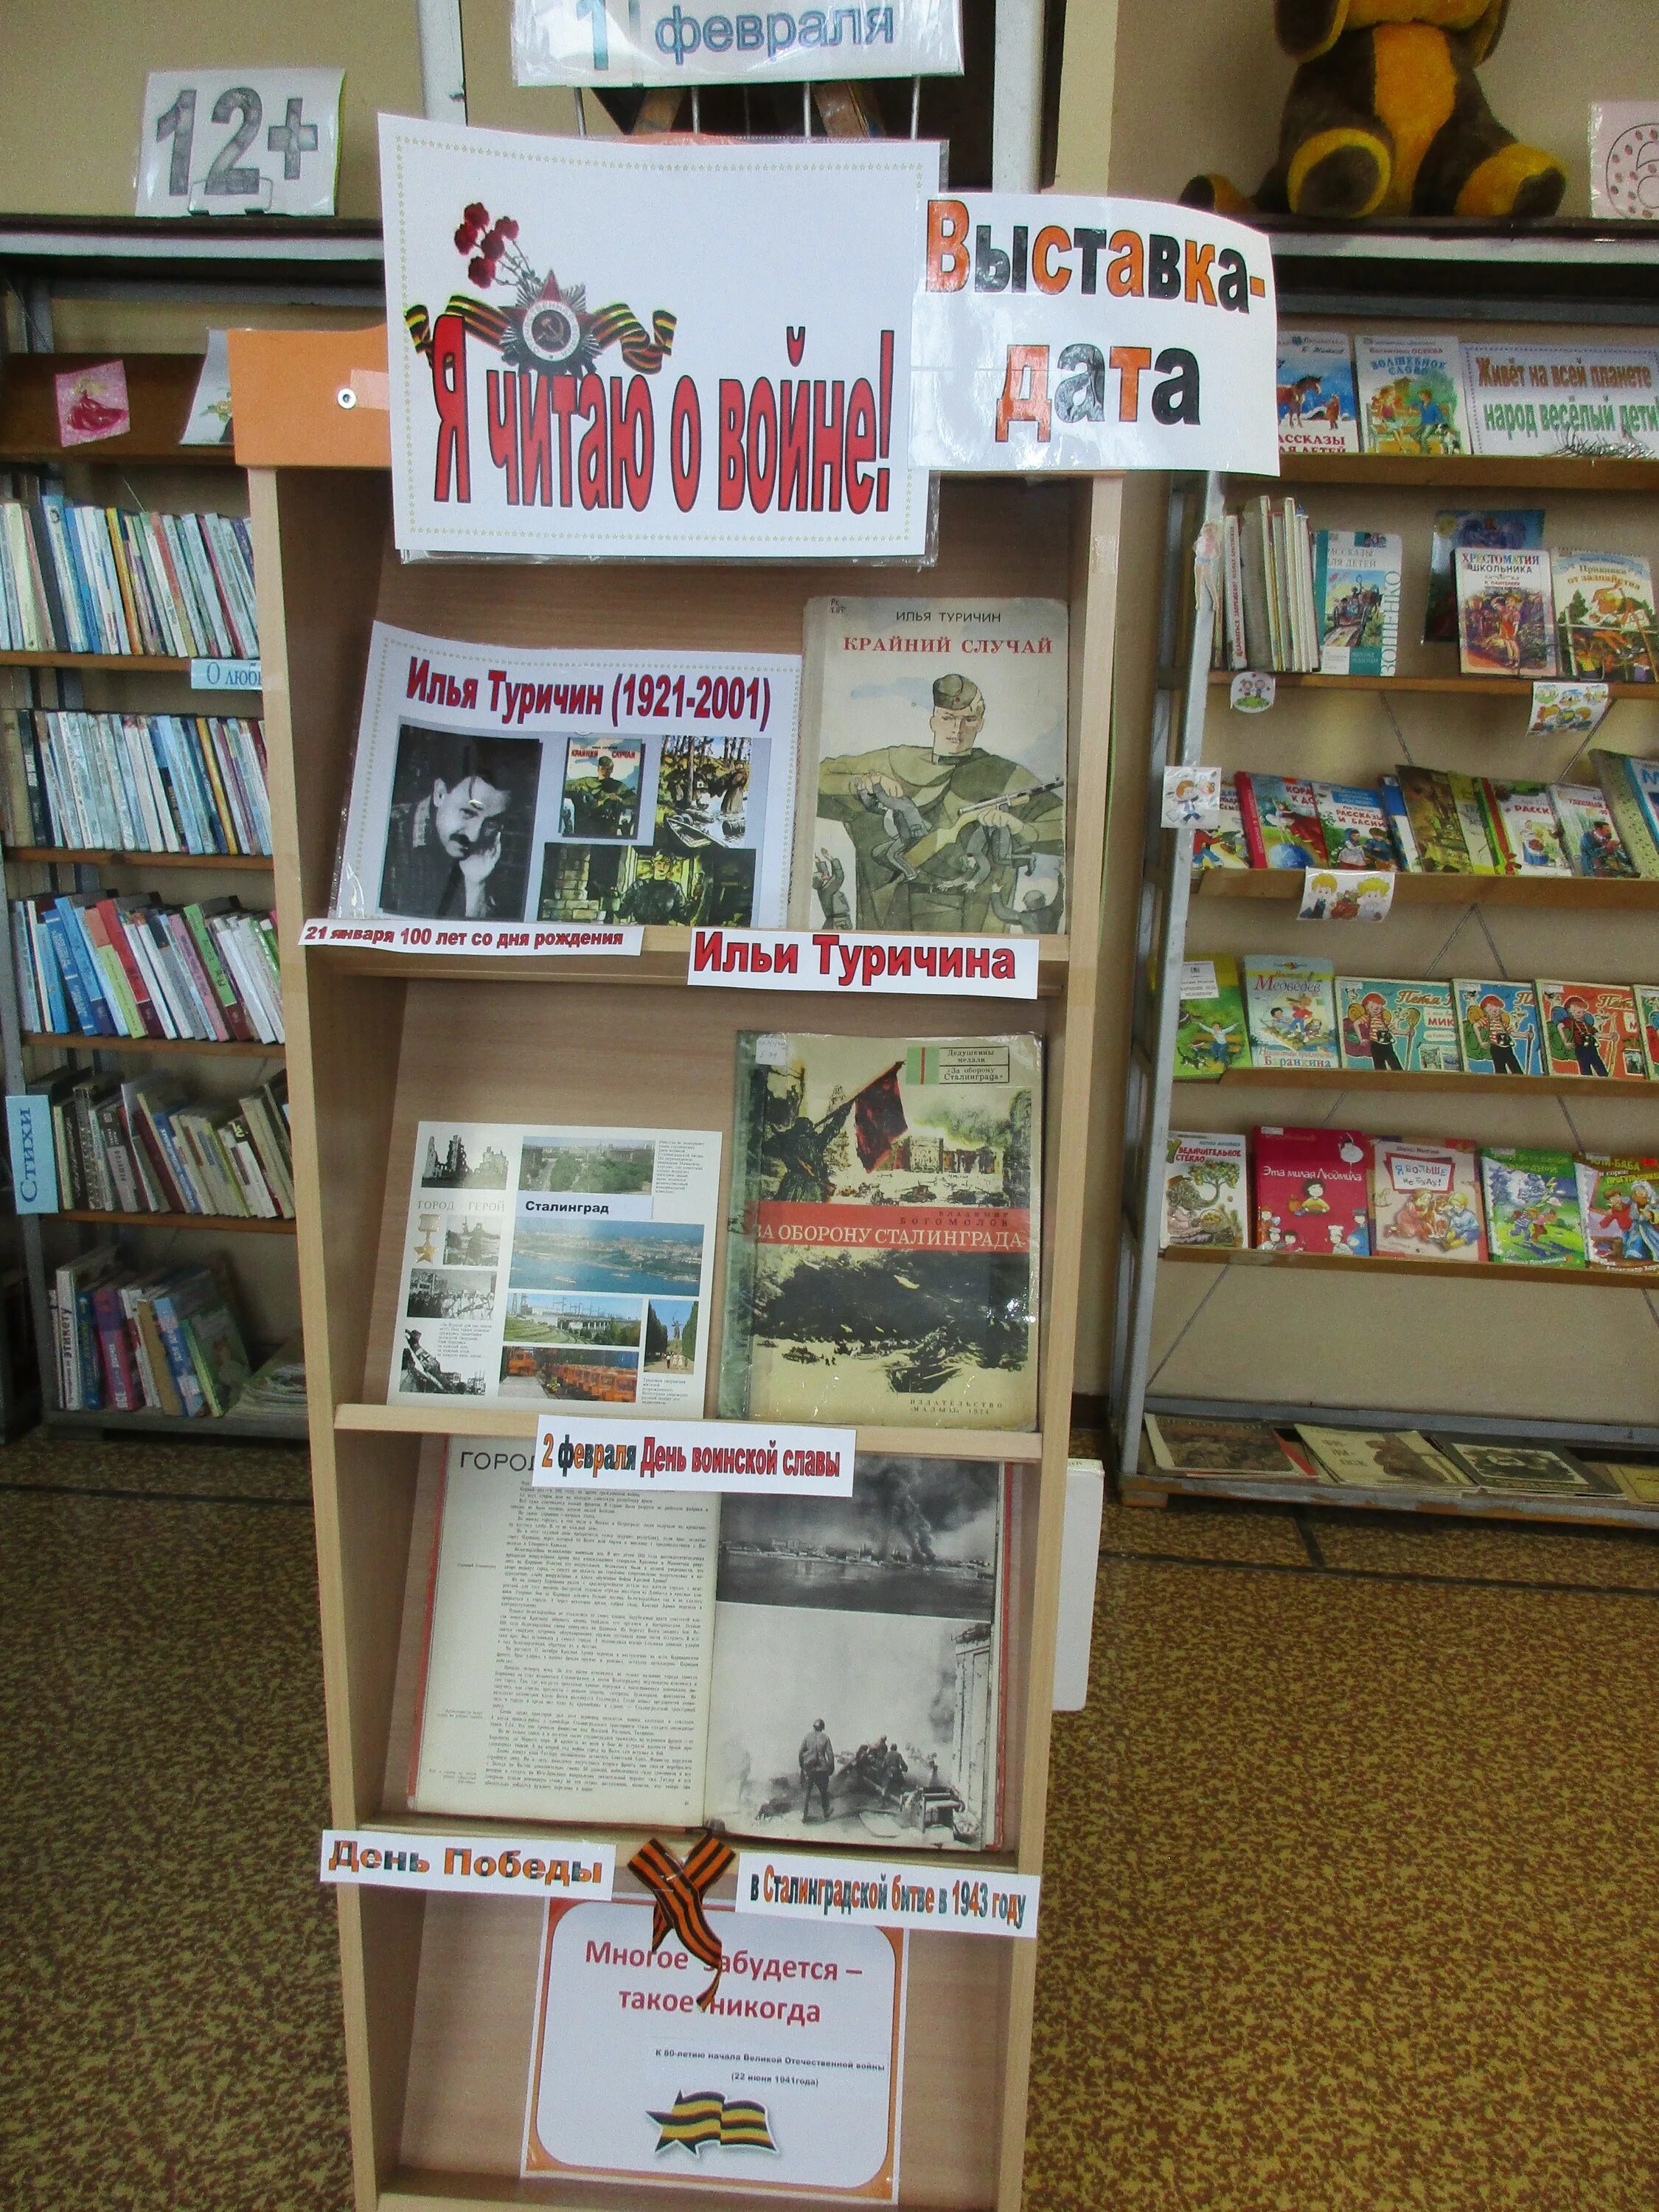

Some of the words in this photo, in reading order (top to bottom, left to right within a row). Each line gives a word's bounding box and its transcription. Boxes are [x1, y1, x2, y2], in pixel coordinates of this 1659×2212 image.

[655, 6, 894, 65] февраля
[156, 86, 319, 196] 12+
[926, 199, 1266, 315] Выставка-
[1528, 365, 1549, 388] на
[1551, 357, 1587, 388] всей
[1590, 365, 1652, 389] планете
[995, 343, 1200, 442] дата
[433, 314, 472, 504] Я
[486, 369, 655, 511] читаю
[669, 375, 703, 512] о
[717, 325, 895, 514] войне!
[1483, 404, 1539, 441] народ
[1540, 394, 1616, 431] весёлый
[1278, 434, 1345, 446] АССКАЗЫ
[1462, 553, 1540, 566] ХРЕСТОМАТИЯ
[1469, 563, 1533, 574] ШКОЛЬНИКА
[897, 611, 931, 622] ИЛЬЯ
[939, 612, 1001, 623] ТУРИЧИН
[843, 636, 951, 653] КРАЙНИЙ
[961, 637, 1053, 653] СЛУЧАЙ
[207, 661, 220, 684] О
[406, 656, 478, 709] Илья
[488, 670, 602, 724] Туричин
[612, 672, 771, 731] (1921-2001)
[305, 926, 325, 939] 21
[330, 929, 394, 943] января
[400, 928, 431, 945] 100
[436, 931, 466, 945] лет
[471, 931, 492, 946] со
[497, 932, 529, 949] дня
[534, 932, 623, 950] рождения
[694, 931, 799, 973] Ильи
[813, 934, 1015, 986] Туричина
[1253, 973, 1321, 992] Медведев
[20, 1107, 38, 1203] Стихи
[1262, 1165, 1285, 1178] Эта
[1287, 1169, 1316, 1180] милая
[1317, 1167, 1363, 1182] Людмила
[417, 1200, 455, 1211] ГОРОД
[468, 1200, 505, 1212] ГЕРОЙ
[525, 1200, 610, 1215] Сталинград
[900, 1217, 1009, 1227] БОГОМОЛОВ
[778, 1225, 872, 1243] ОБОРОНУ
[874, 1229, 1022, 1251] СТАЛИНГРАДА
[541, 1433, 554, 1468] 2
[557, 1434, 637, 1477] февраля
[639, 1436, 687, 1478] День
[692, 1440, 777, 1475] воинской
[782, 1448, 841, 1478] славы
[330, 1840, 430, 1874] День
[444, 1847, 602, 1885] Победы
[750, 1884, 759, 1902] в
[762, 1865, 888, 1910] Сталинградской
[891, 1878, 936, 1910] битве
[939, 1891, 948, 1913] в
[952, 1878, 989, 1917] 1943
[992, 1891, 1026, 1928] году
[585, 1941, 689, 1970] Многое
[702, 1950, 838, 1982] абудется
[619, 1990, 693, 2013] такое
[709, 1999, 821, 2026] никогда
[708, 2052, 741, 2060] начала
[743, 2053, 782, 2064] Великой
[785, 2057, 853, 2069] Отечественной
[855, 2061, 885, 2071] войны
[731, 2073, 745, 2082] (22
